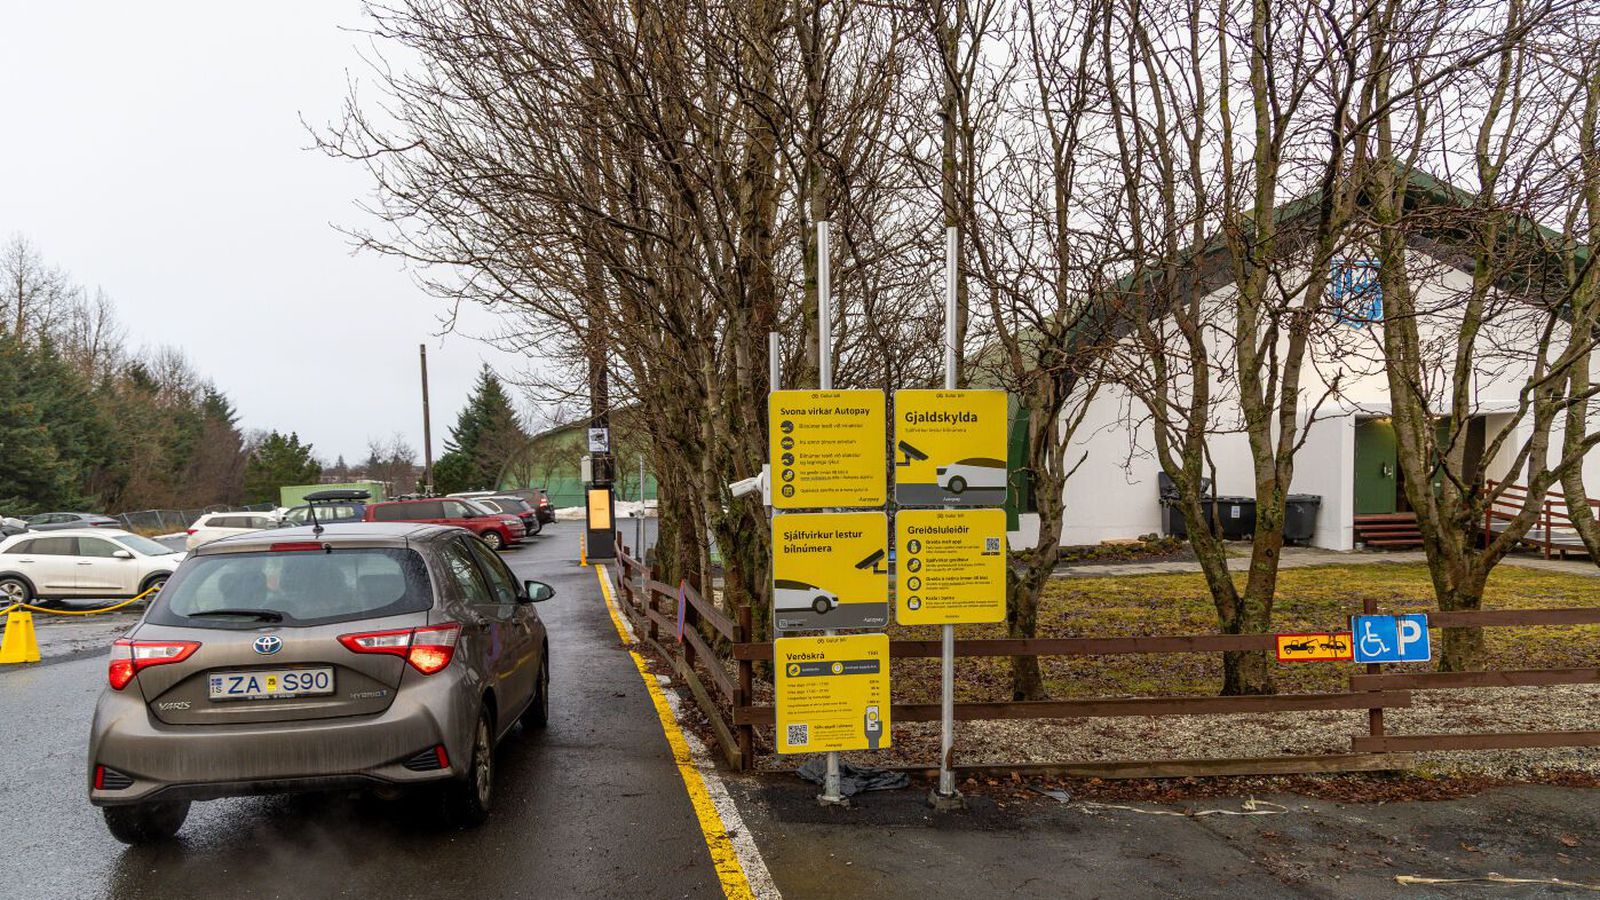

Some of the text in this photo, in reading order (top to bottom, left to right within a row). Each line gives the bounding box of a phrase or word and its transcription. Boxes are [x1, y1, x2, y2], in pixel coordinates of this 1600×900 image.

[780, 407, 870, 416] Svona virkar Autopay
[905, 411, 978, 425] Gjaldskylda
[907, 525, 970, 535] Greiðsluleiðir
[783, 530, 863, 542] Sjálfvirkur lestur
[784, 544, 832, 554] bílnúmera
[1397, 620, 1422, 656] P
[785, 651, 825, 661] Verðskrá
[228, 676, 261, 694] ZA
[283, 671, 329, 691] S90
